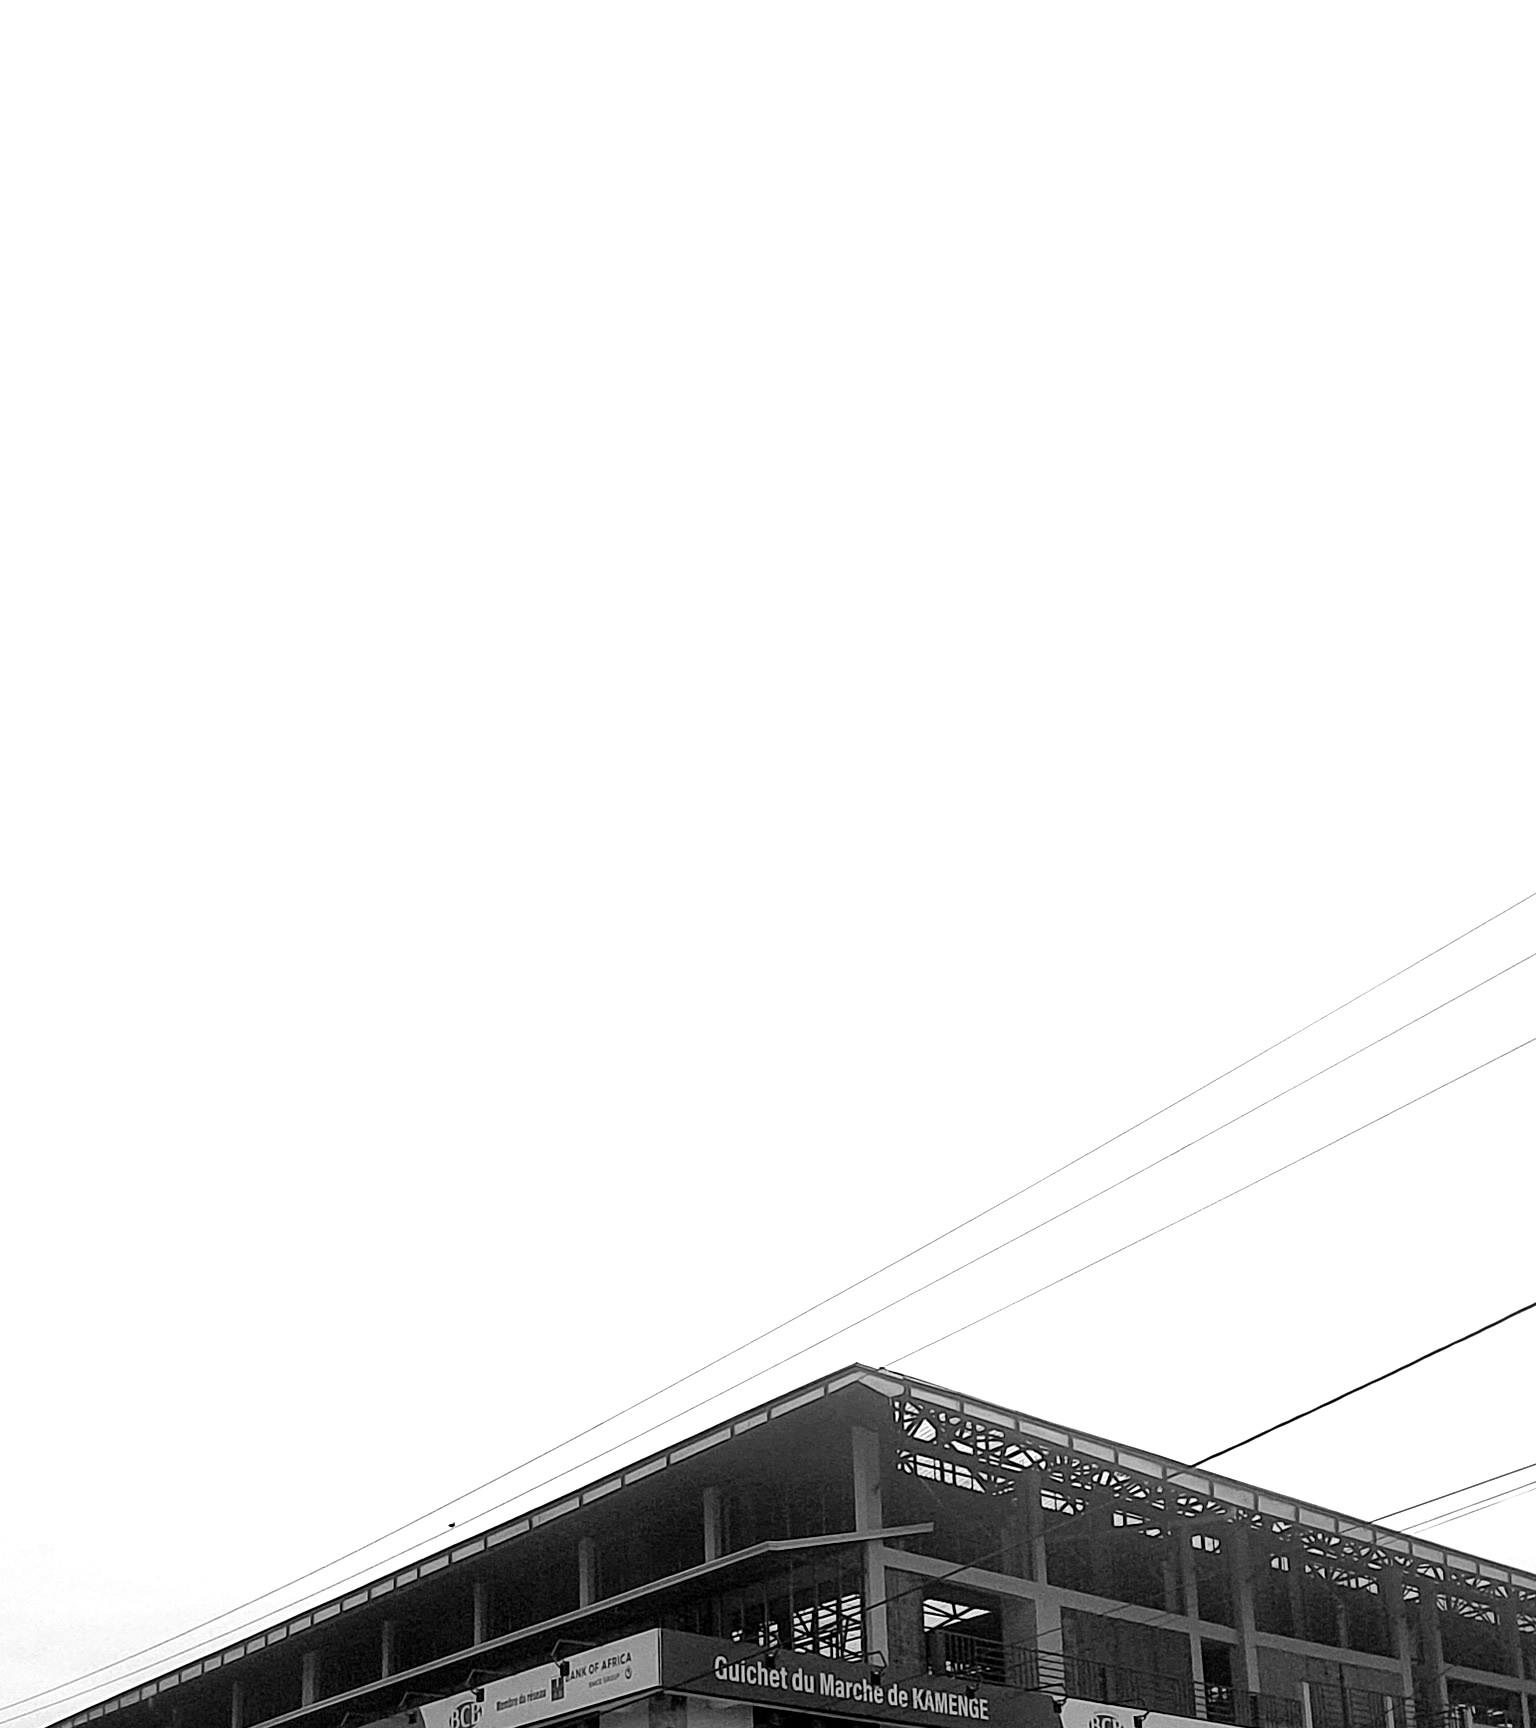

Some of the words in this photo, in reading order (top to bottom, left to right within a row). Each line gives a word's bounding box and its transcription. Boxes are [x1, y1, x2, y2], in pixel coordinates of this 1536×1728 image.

[565, 1667, 587, 1682] ANK
[588, 1662, 600, 1674] OF
[601, 1652, 632, 1669] AFRICA
[714, 1655, 788, 1690] Guichet
[791, 1667, 815, 1694] du
[887, 1683, 909, 1709] de
[912, 1687, 990, 1721] KAMENGE
